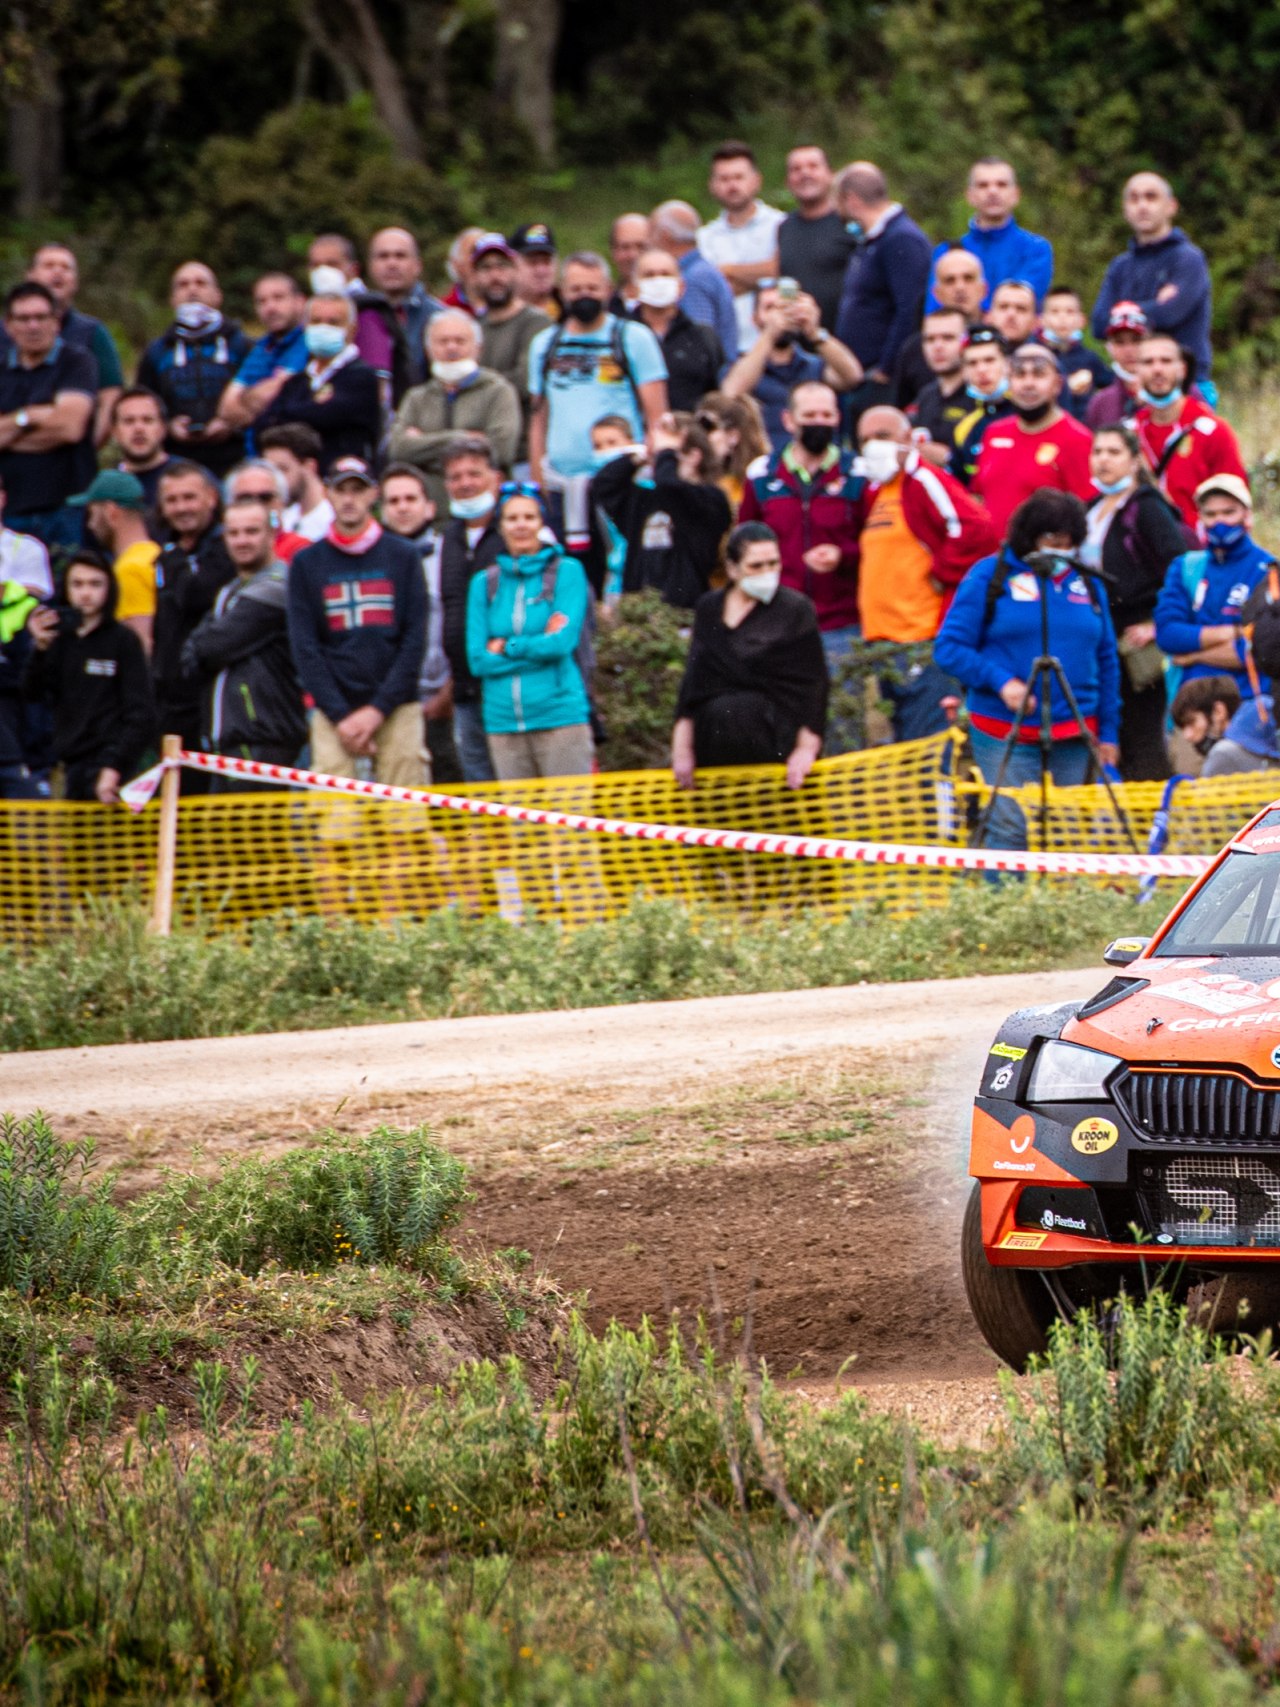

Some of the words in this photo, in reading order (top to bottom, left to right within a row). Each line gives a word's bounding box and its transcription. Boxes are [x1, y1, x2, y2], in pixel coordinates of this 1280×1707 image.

[1077, 1131, 1111, 1142] KROON
[1084, 1141, 1098, 1151] OIL
[1054, 1214, 1087, 1231] Fleetback
[1005, 1234, 1040, 1248] PIRELLI
